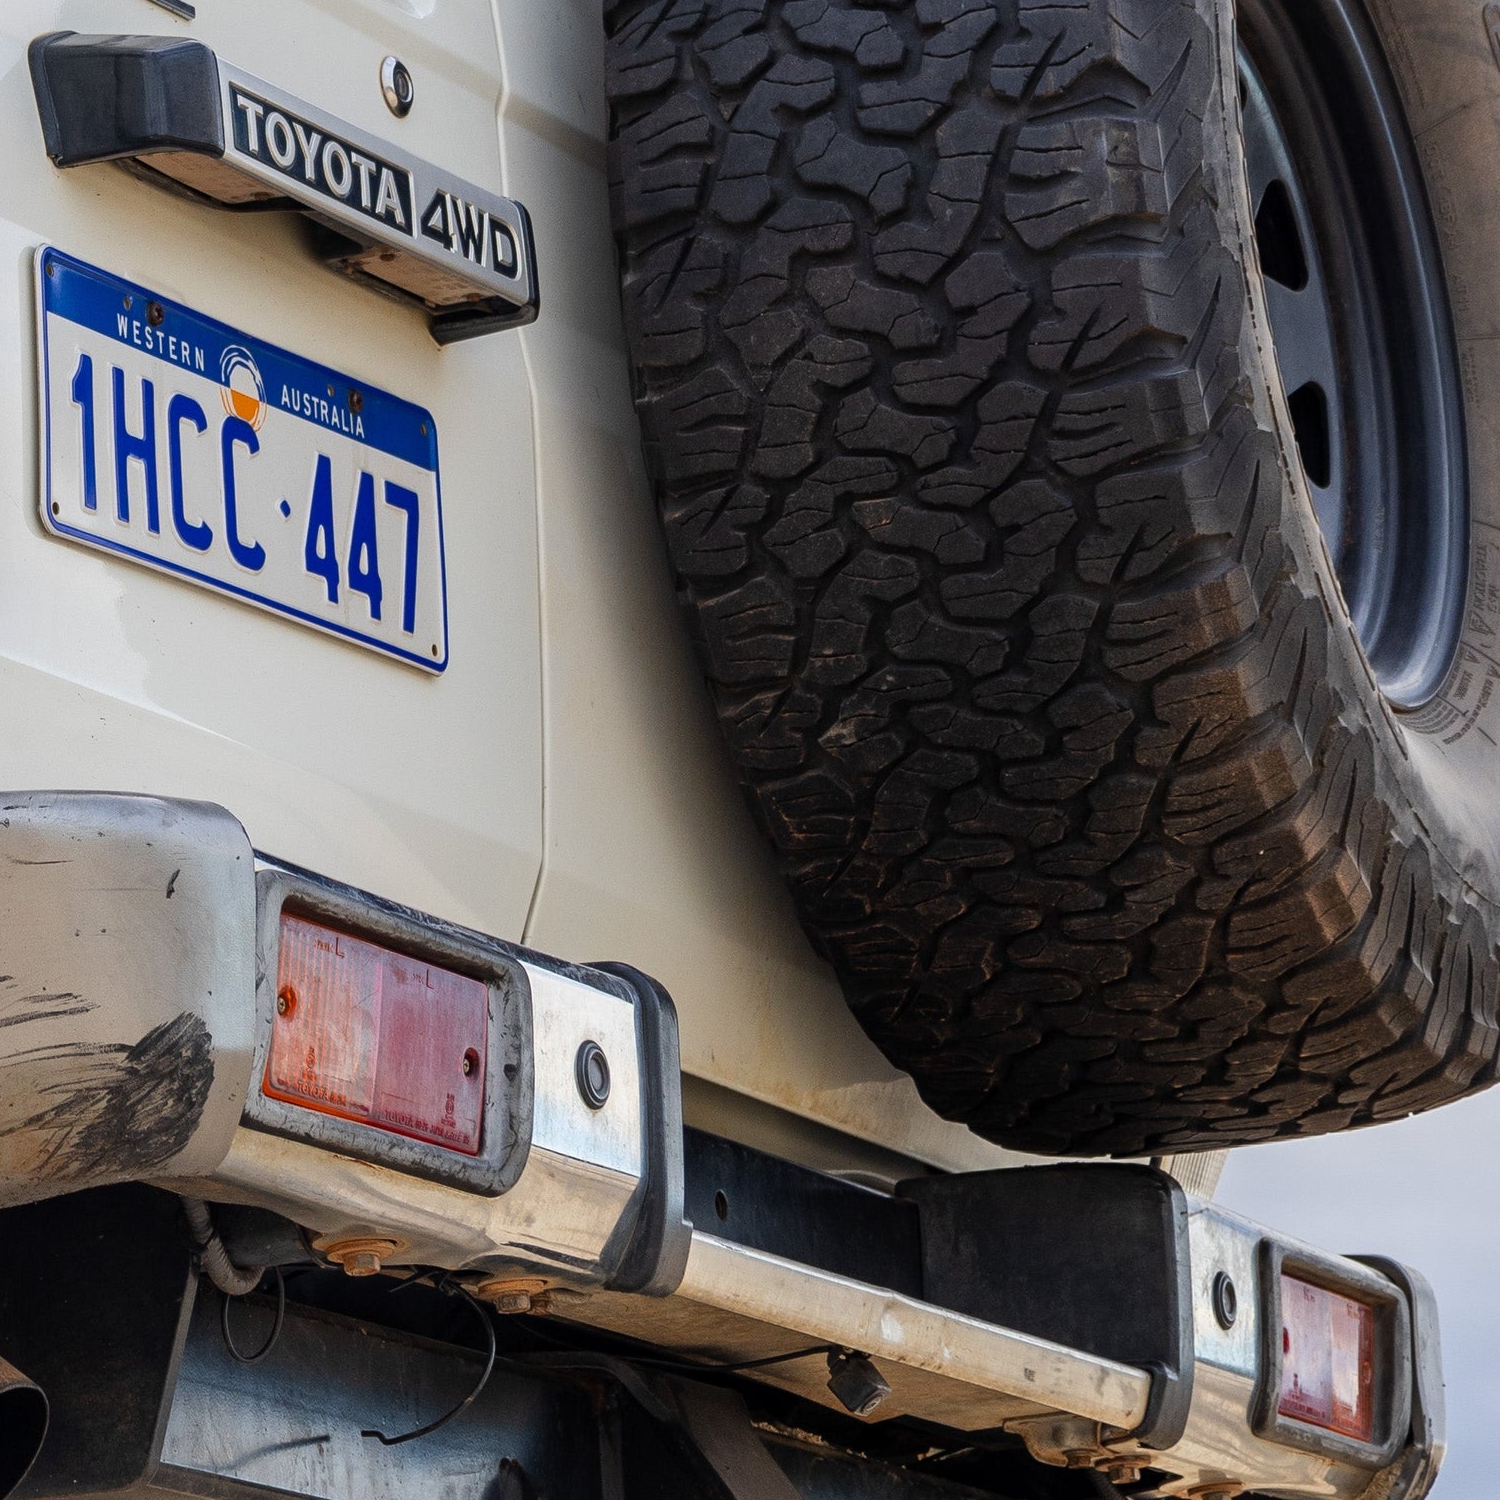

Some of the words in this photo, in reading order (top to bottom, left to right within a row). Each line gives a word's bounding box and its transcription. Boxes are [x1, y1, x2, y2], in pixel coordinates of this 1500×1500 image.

[234, 92, 412, 230] TOYOTA
[421, 188, 521, 281] 4WD
[116, 312, 205, 372] WESTERN
[281, 384, 366, 439] AUSTRALIA
[297, 1080, 329, 1101] TOYOTA
[384, 1109, 414, 1128] TOYOTA
